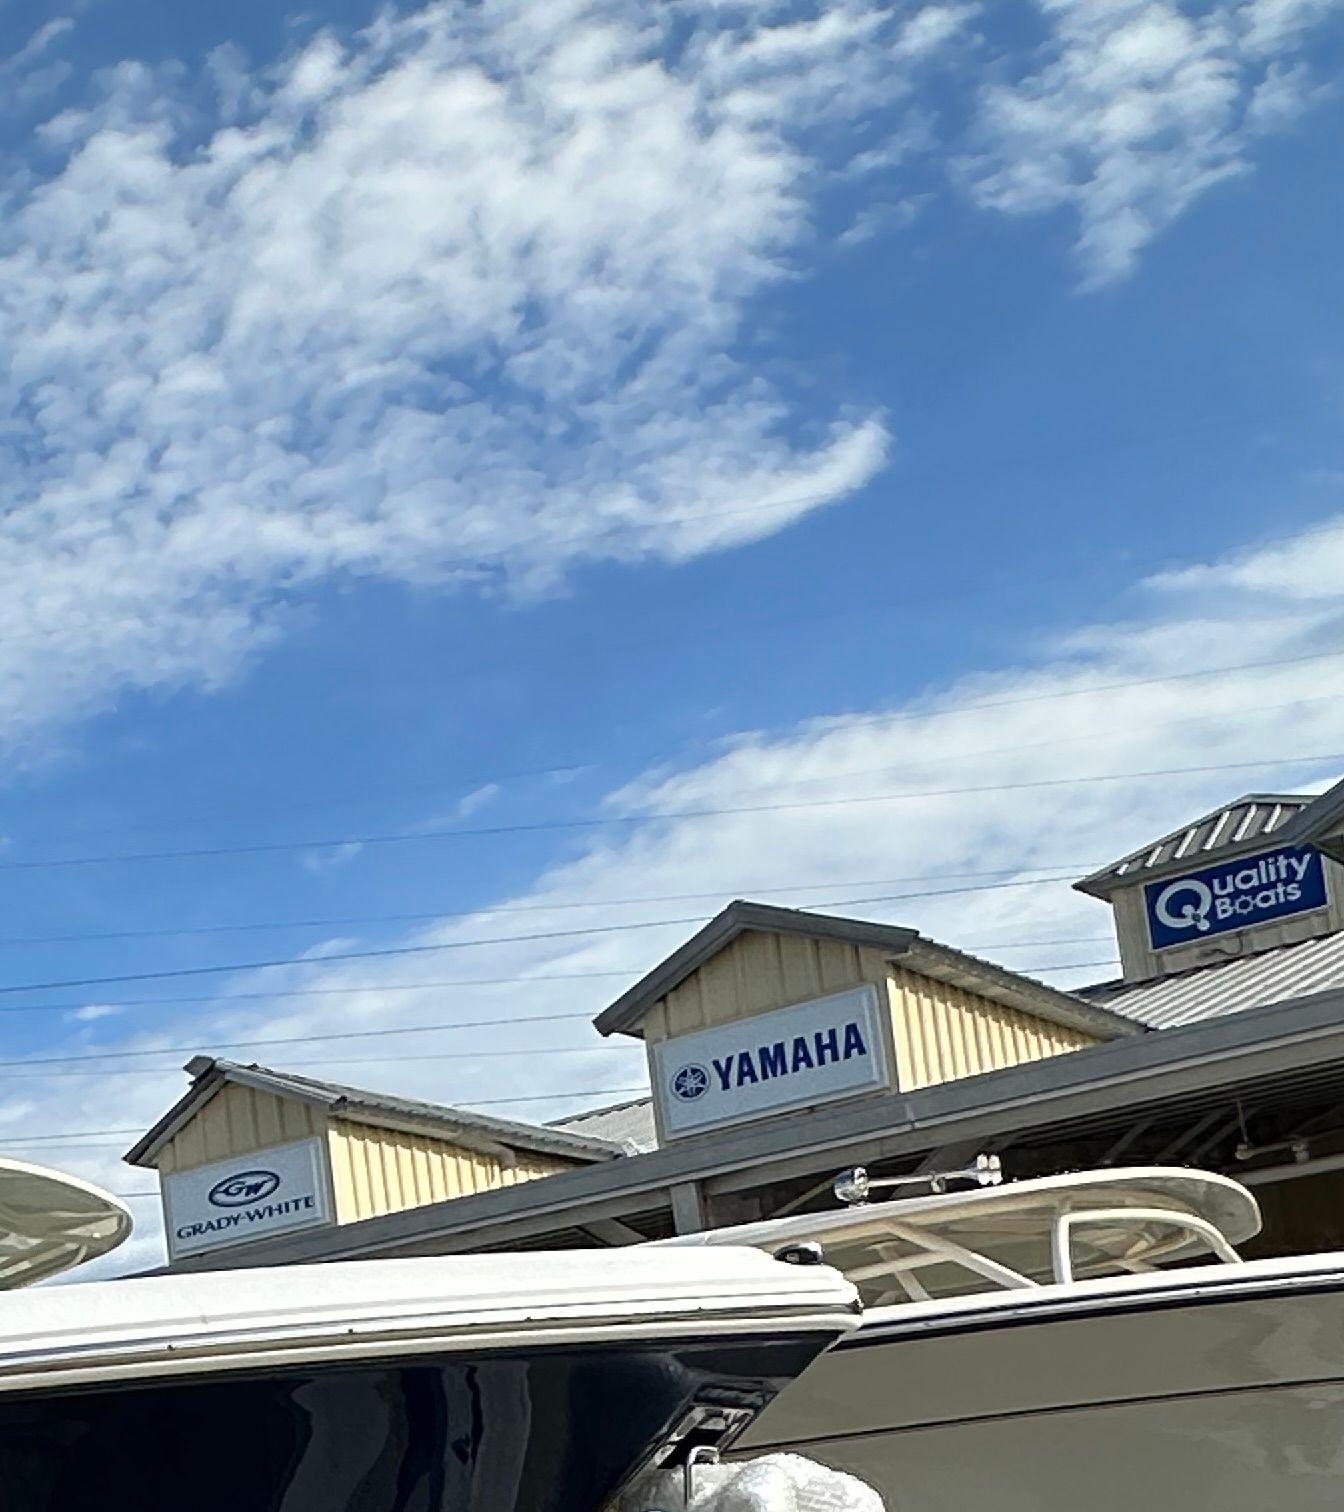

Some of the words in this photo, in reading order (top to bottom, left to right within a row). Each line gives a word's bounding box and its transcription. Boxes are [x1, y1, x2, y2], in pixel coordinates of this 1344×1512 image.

[1214, 881, 1302, 920] Boats
[713, 1022, 867, 1091] YAMAHA
[177, 1196, 315, 1238] GRADY-WHITE
